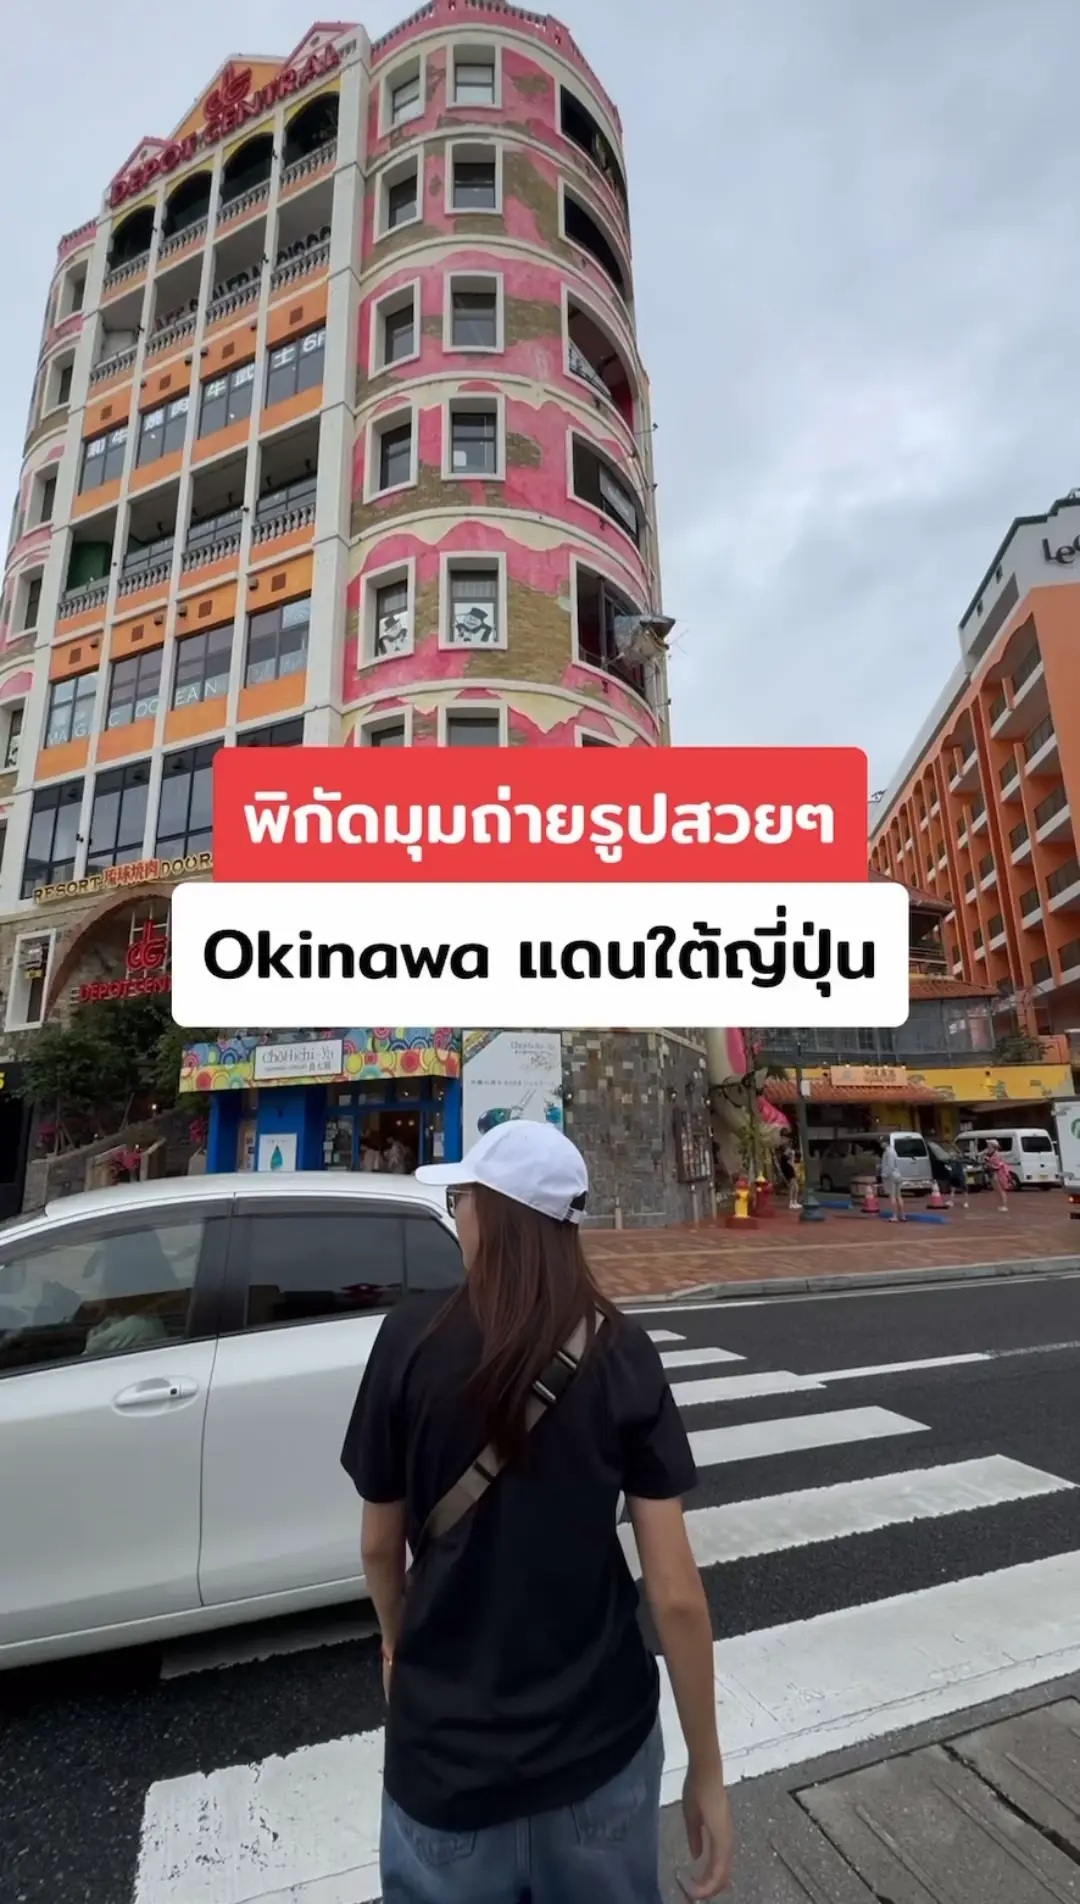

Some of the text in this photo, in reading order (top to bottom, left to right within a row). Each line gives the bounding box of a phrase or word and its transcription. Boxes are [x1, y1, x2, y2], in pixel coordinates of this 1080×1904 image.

[108, 43, 340, 207] DEPOT CENTRAL
[49, 711, 121, 746] MAGC
[34, 876, 99, 903] RESORT
[161, 852, 212, 877] DOUR
[79, 979, 129, 1003] DEPOT
